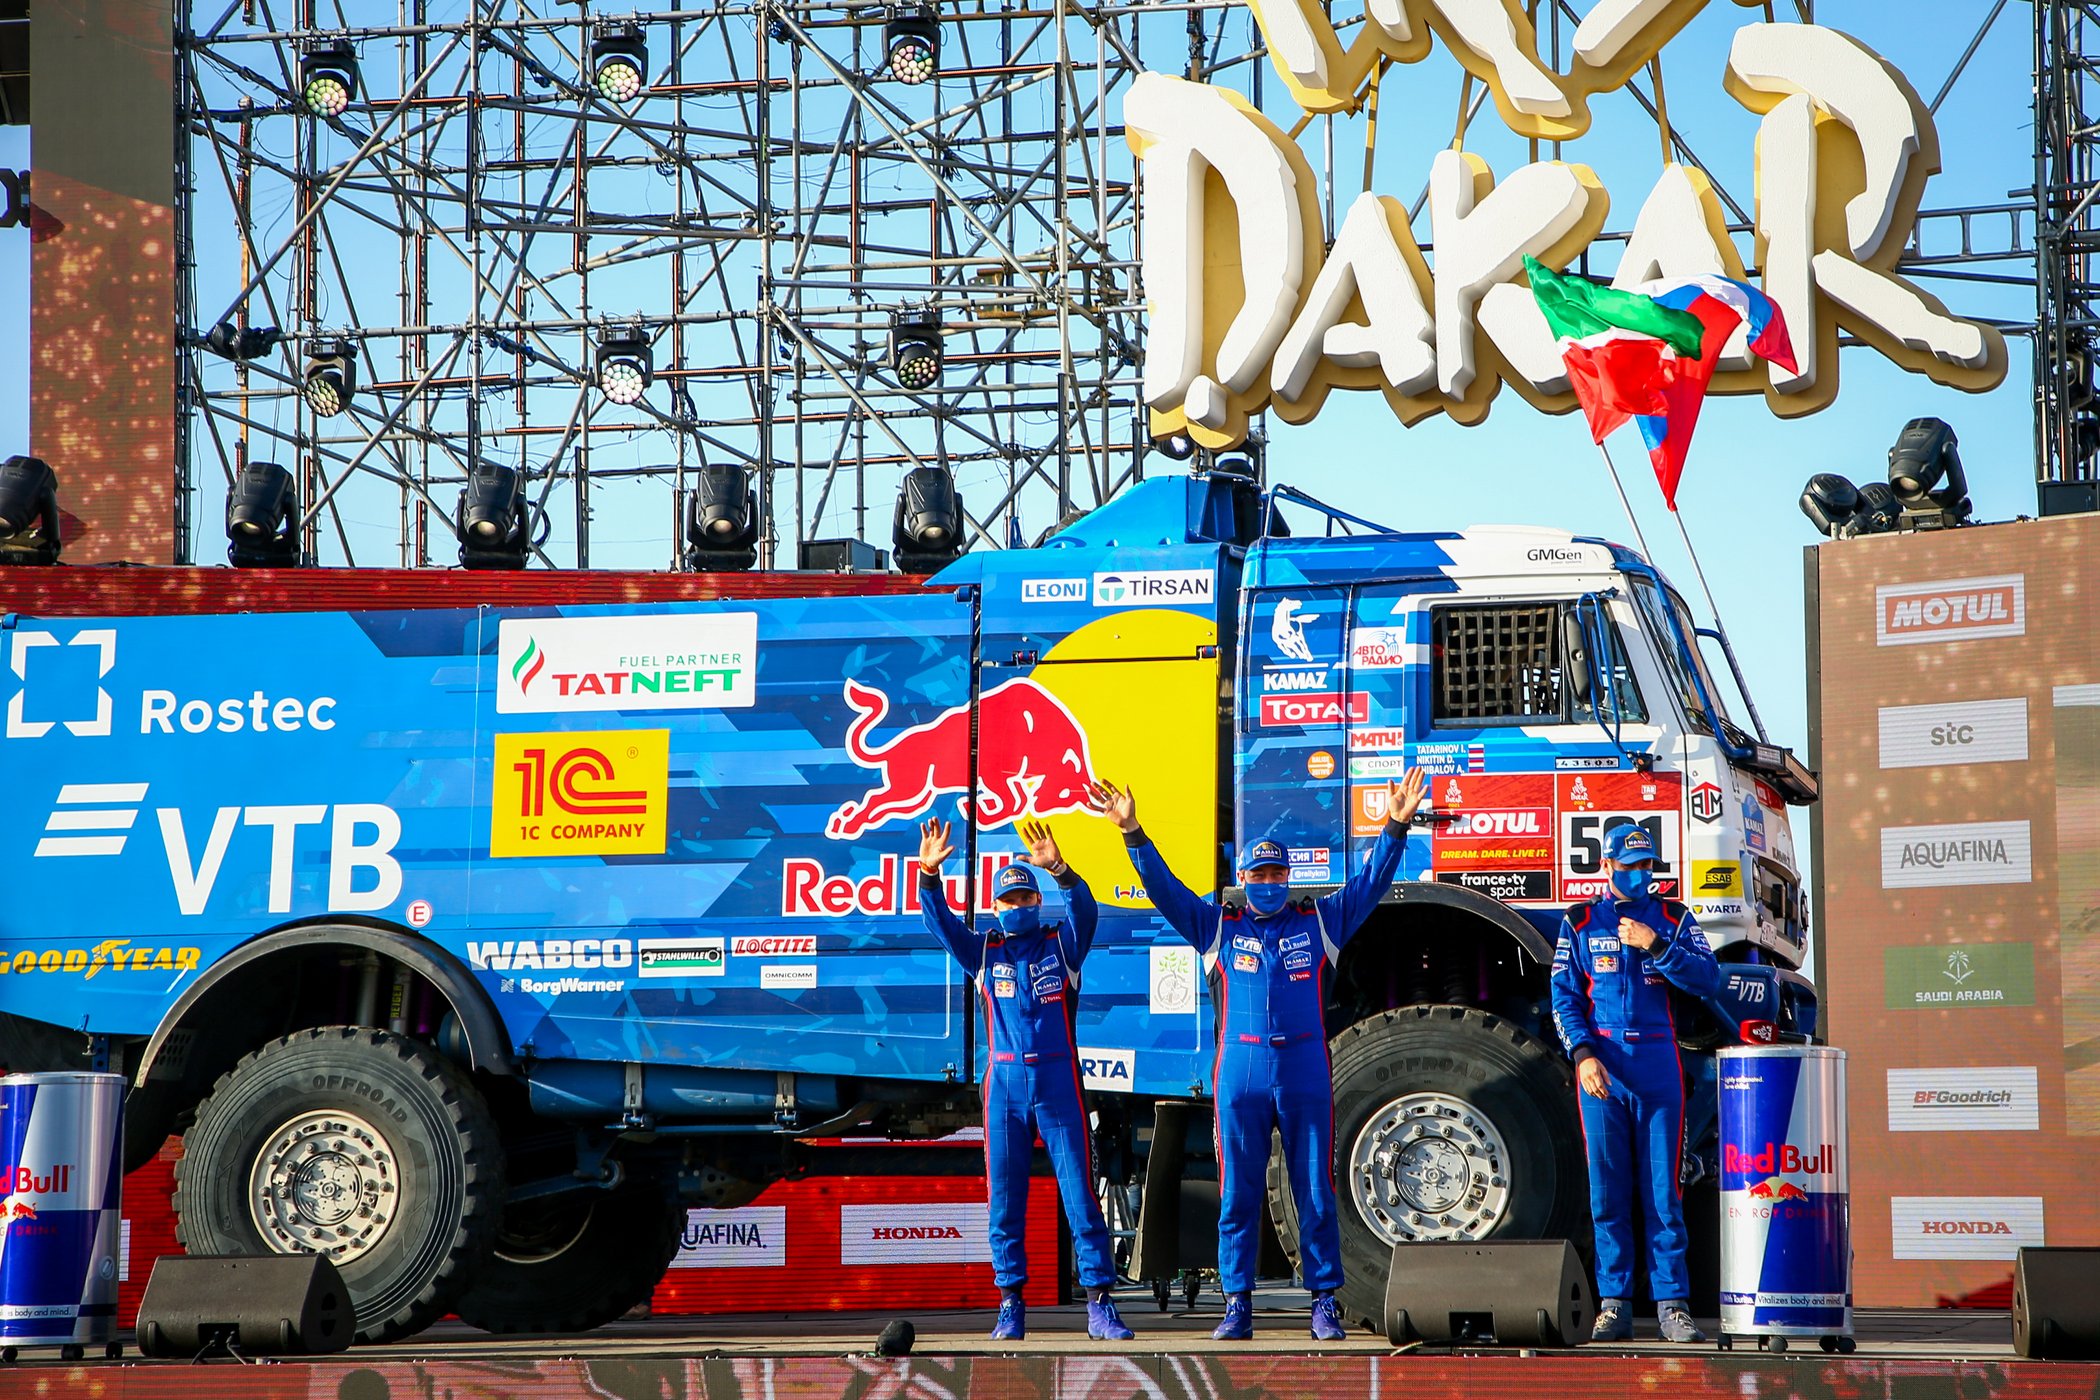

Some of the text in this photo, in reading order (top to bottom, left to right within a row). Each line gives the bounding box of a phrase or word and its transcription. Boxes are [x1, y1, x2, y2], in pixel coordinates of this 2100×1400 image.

[1124, 22, 2005, 448] DAKAR
[1527, 548, 1582, 562] GMGen
[1025, 583, 1084, 598] LEONI
[1891, 593, 2008, 628] MOTUL
[1352, 645, 1385, 656] АВТО
[619, 653, 742, 668] FUEL PARTNER
[552, 669, 741, 696] TATNEFT
[1263, 672, 1328, 690] KAMAZ
[140, 690, 337, 734] Rostec
[1266, 700, 1363, 720] TOTAL
[1930, 722, 1974, 746] stc
[1416, 744, 1459, 754] TATARINOV
[1416, 754, 1455, 764] NIKITIN D.
[1421, 764, 1464, 774] HIBALOV A.
[1446, 812, 1540, 834] MOTUL
[1744, 817, 1764, 835] KAMAZ
[521, 823, 645, 841] 1C COMPANY
[156, 803, 403, 916] VTB
[1288, 851, 1327, 862] СИЯ 24
[1441, 849, 1548, 859] DREAM. DARE. LIVE IT.
[785, 857, 894, 914] Red
[1705, 874, 1732, 883] ESAB
[1490, 885, 1526, 900] sport
[1706, 904, 1742, 913] VARTA
[735, 938, 814, 955] LOCTITE
[1244, 941, 1261, 951] VTB
[1600, 940, 1618, 950] VTB
[466, 939, 632, 971] WABCO
[521, 978, 624, 995] BorgWarner
[1738, 981, 1765, 1003] VTB
[1915, 989, 2004, 1002] SAUDI ARABIA
[1082, 1058, 1129, 1079] RTA
[1375, 1056, 1487, 1082] OFFROAD
[312, 1074, 407, 1123] OFFROAD
[1913, 1090, 2011, 1104] BFGoodrich
[1725, 1142, 1833, 1174] Red Bull
[16, 1165, 69, 1194] Bull
[1729, 1207, 1779, 1219] ENRGY
[872, 1226, 963, 1240] HONDA
[1922, 1221, 2012, 1235] HONDA
[1758, 1295, 1788, 1304] Vitalizes
[1790, 1295, 1810, 1307] body
[1811, 1295, 1825, 1304] and
[15, 1305, 33, 1318] body
[34, 1304, 48, 1316] and
[49, 1304, 72, 1316] mind.
